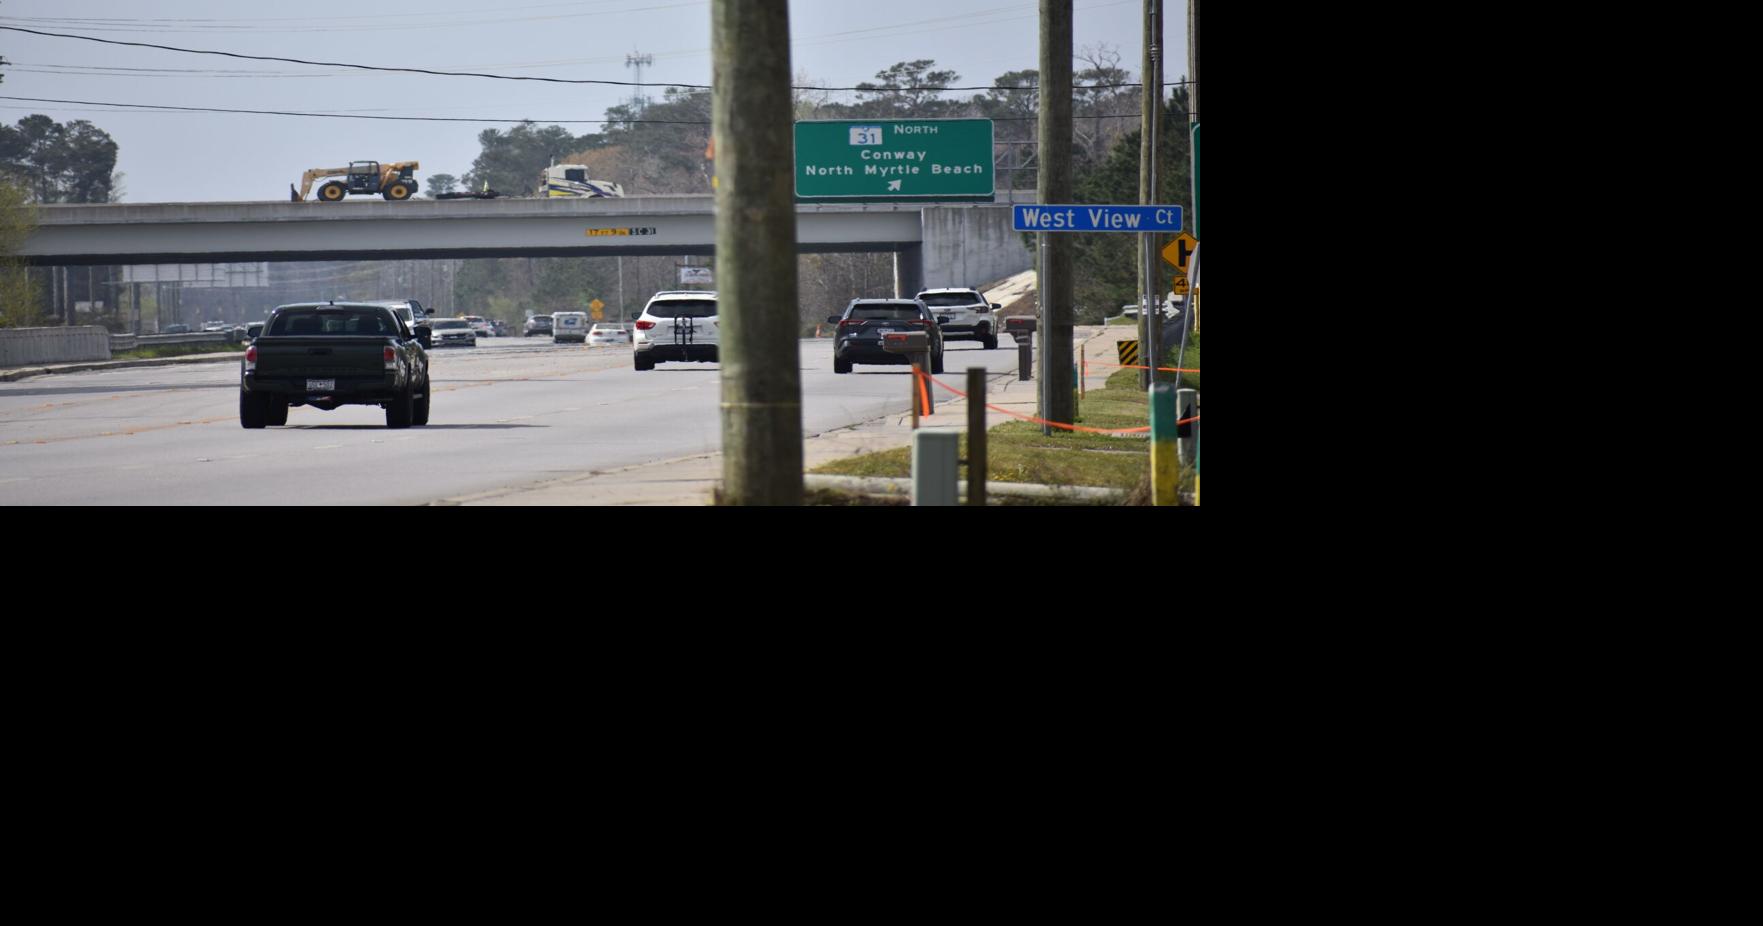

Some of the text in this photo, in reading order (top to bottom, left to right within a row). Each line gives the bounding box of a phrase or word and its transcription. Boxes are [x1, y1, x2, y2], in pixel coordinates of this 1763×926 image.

[857, 132, 876, 145] 31
[861, 150, 927, 161] Conway
[806, 163, 984, 177] North Myrtle Beach
[1022, 208, 1174, 229] West View Ct
